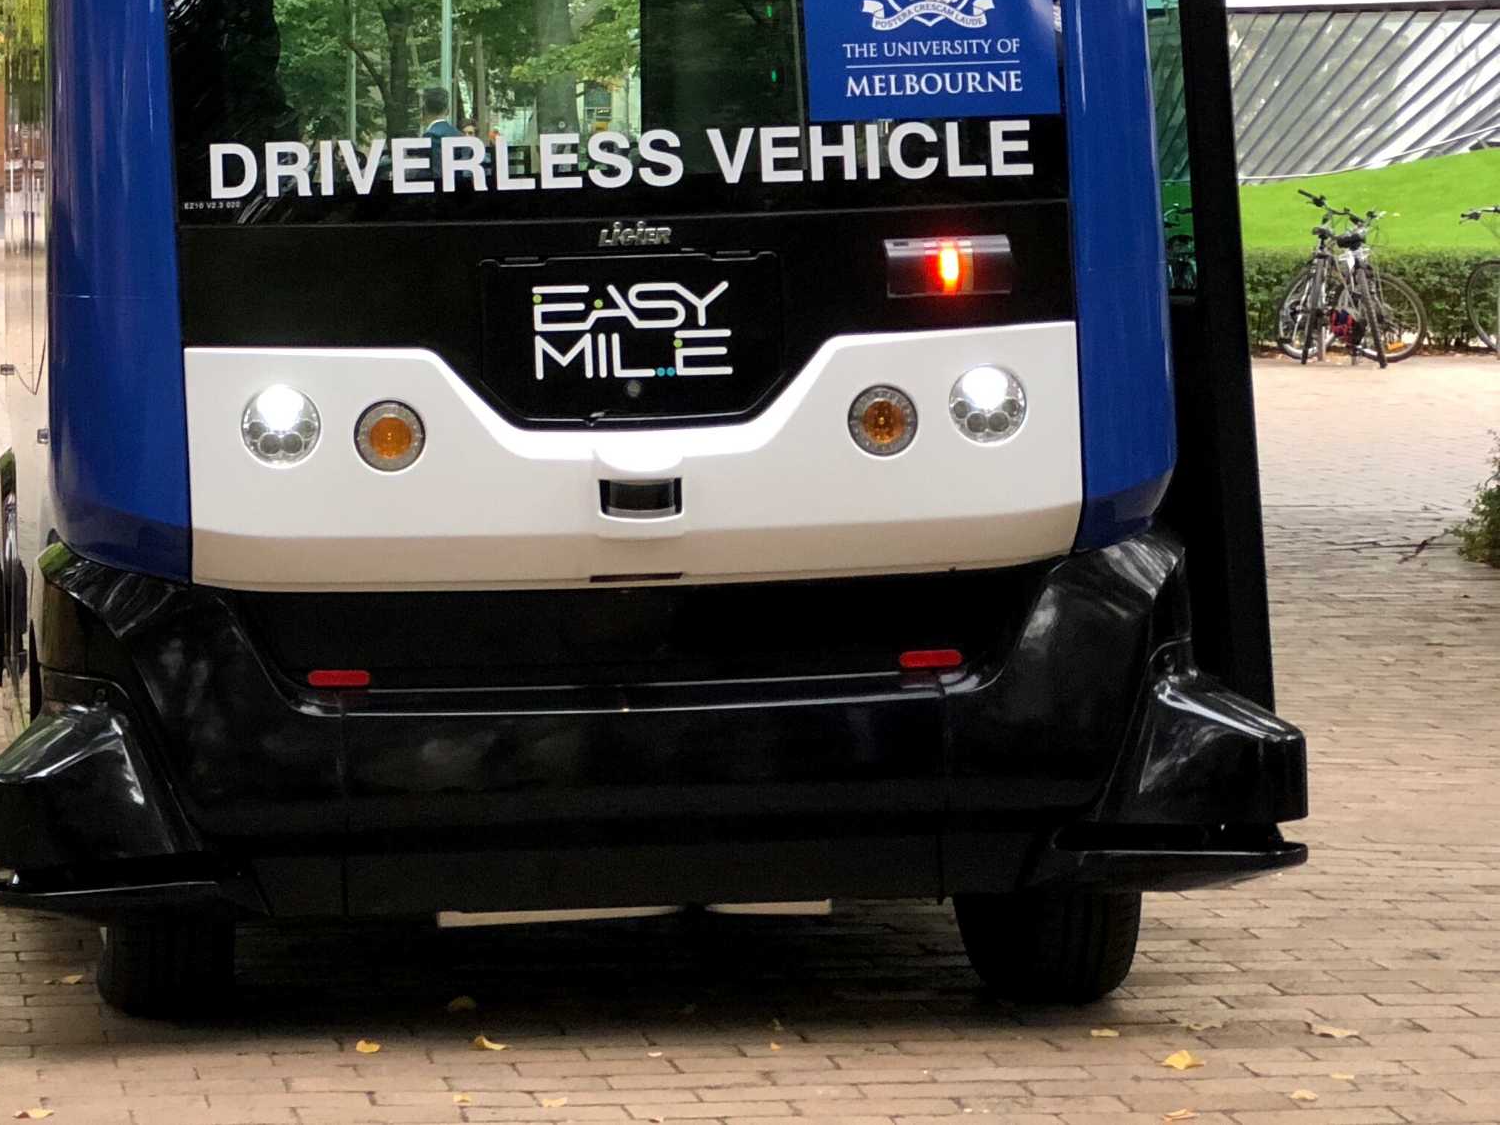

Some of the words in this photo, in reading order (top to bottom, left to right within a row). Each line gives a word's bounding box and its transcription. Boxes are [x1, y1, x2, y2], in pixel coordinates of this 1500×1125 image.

[874, 8, 914, 28] POSTERA
[913, 3, 955, 19] CRESCAM
[954, 13, 985, 27] LAUDE
[842, 42, 878, 58] THE
[883, 39, 992, 57] UNIVERSITY
[997, 38, 1021, 54] OF
[845, 70, 1023, 97] MELBOURNE
[209, 128, 684, 200] DRIVERLESS
[706, 119, 1034, 184] VEHICLE
[532, 280, 729, 332] EASY
[533, 329, 733, 381] MILE
